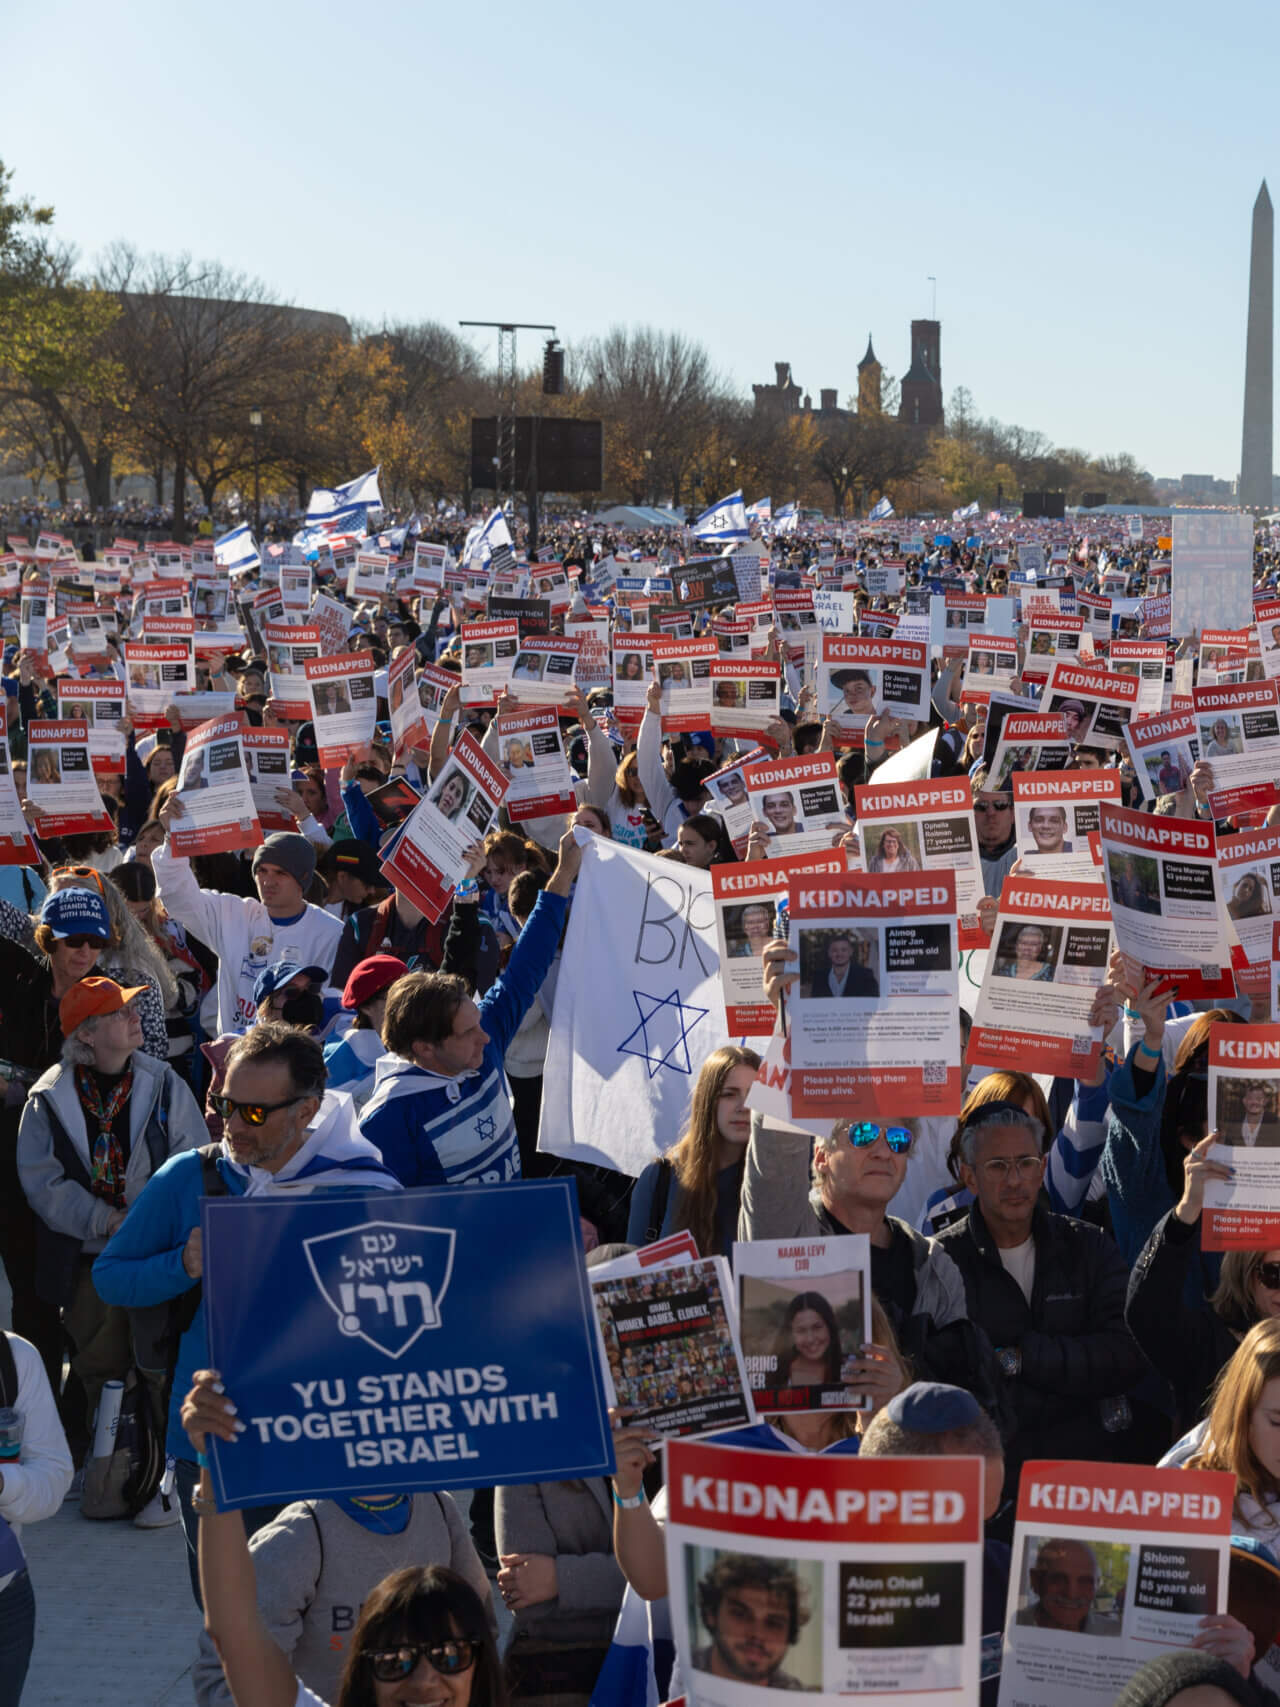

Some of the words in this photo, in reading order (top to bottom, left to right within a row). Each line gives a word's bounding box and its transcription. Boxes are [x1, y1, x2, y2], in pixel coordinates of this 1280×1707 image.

[1030, 595, 1050, 604] FREE
[522, 619, 548, 627] NOW
[1031, 618, 1081, 629] KIDNAPPED
[268, 630, 317, 641] KIDNAPPED
[464, 624, 515, 638] KIDNAPPED
[524, 639, 579, 650] KIDNAPPED
[971, 637, 1017, 649] KIDNAPPED
[1202, 633, 1247, 644] KIDNAPPED
[127, 648, 187, 659] KIDNAPPED
[656, 643, 716, 656] KIDNAPPED
[828, 642, 922, 661] KIDNAPPED
[1111, 646, 1164, 656] KIDNAPPED
[308, 658, 371, 675] KIDNAPPED
[713, 664, 777, 675] KIDNAPPED
[1058, 671, 1135, 695] KIDNAPPED
[61, 685, 122, 696] KIDNAPPED
[1197, 689, 1273, 706] KIDNAPPED
[500, 714, 555, 732] KIDNAPPED
[31, 728, 86, 739] KIDNAPPED
[188, 719, 239, 745] KIDNAPPED
[458, 742, 503, 798] KIDNAPPED
[749, 762, 832, 786] KIDNAPPED
[1017, 779, 1115, 796] KIDNAPPED
[861, 789, 966, 811] KIDNAPPED
[1105, 817, 1210, 849] KIDNAPPED
[800, 887, 948, 909] KIDNAPPED
[889, 927, 916, 940] Almog
[889, 937, 907, 947] Meir
[909, 937, 924, 946] Jan
[889, 947, 902, 957] 21
[904, 947, 925, 959] years
[928, 946, 939, 955] old
[889, 956, 915, 967] Israeli
[361, 1233, 396, 1254] עם
[808, 1245, 826, 1256] LEVY
[341, 1255, 423, 1278] ישראל
[745, 1355, 777, 1372] BRING
[292, 1378, 346, 1409] YU
[358, 1365, 508, 1402] STANDS
[251, 1403, 452, 1443] TOGETHER
[460, 1392, 558, 1427] WITH
[344, 1433, 479, 1468] ISRAEL
[682, 1474, 966, 1524] KIDNAPPED
[1029, 1482, 1222, 1520] KIDNAPPED
[1143, 1551, 1185, 1565] Shlomo
[1142, 1567, 1190, 1579] Mansour
[847, 1577, 883, 1590] Alon
[887, 1577, 923, 1589] Ohel
[1139, 1580, 1153, 1591] 85
[1155, 1583, 1186, 1596] years
[1189, 1583, 1206, 1594] old
[847, 1595, 866, 1608] 22
[869, 1595, 912, 1610] years
[915, 1593, 940, 1607] old
[1139, 1594, 1173, 1607] Israeli
[847, 1612, 894, 1625] Israeli
